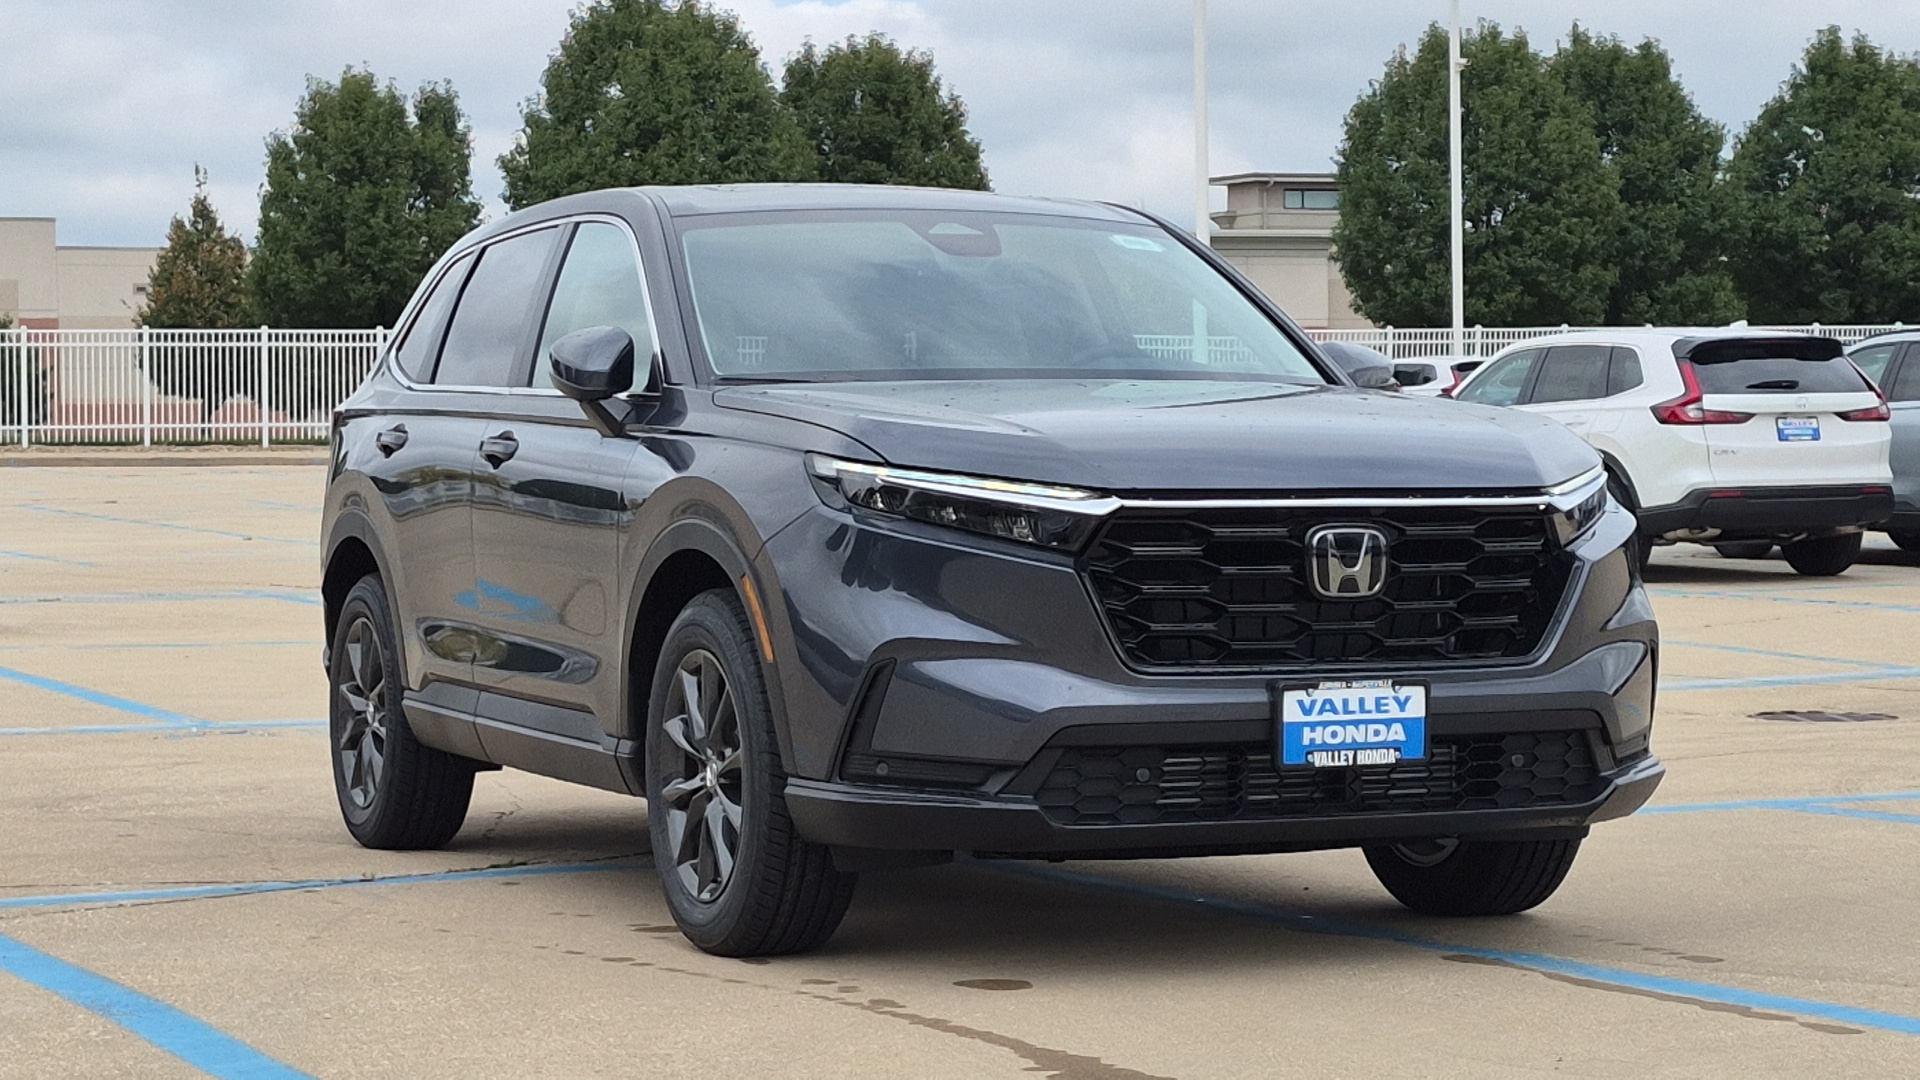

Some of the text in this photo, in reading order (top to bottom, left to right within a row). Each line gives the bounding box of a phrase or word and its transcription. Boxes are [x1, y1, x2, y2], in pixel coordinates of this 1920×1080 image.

[1296, 695, 1411, 716] VALLEY
[1302, 723, 1406, 746] HONDA
[1314, 749, 1396, 767] VALLEY HONDA
